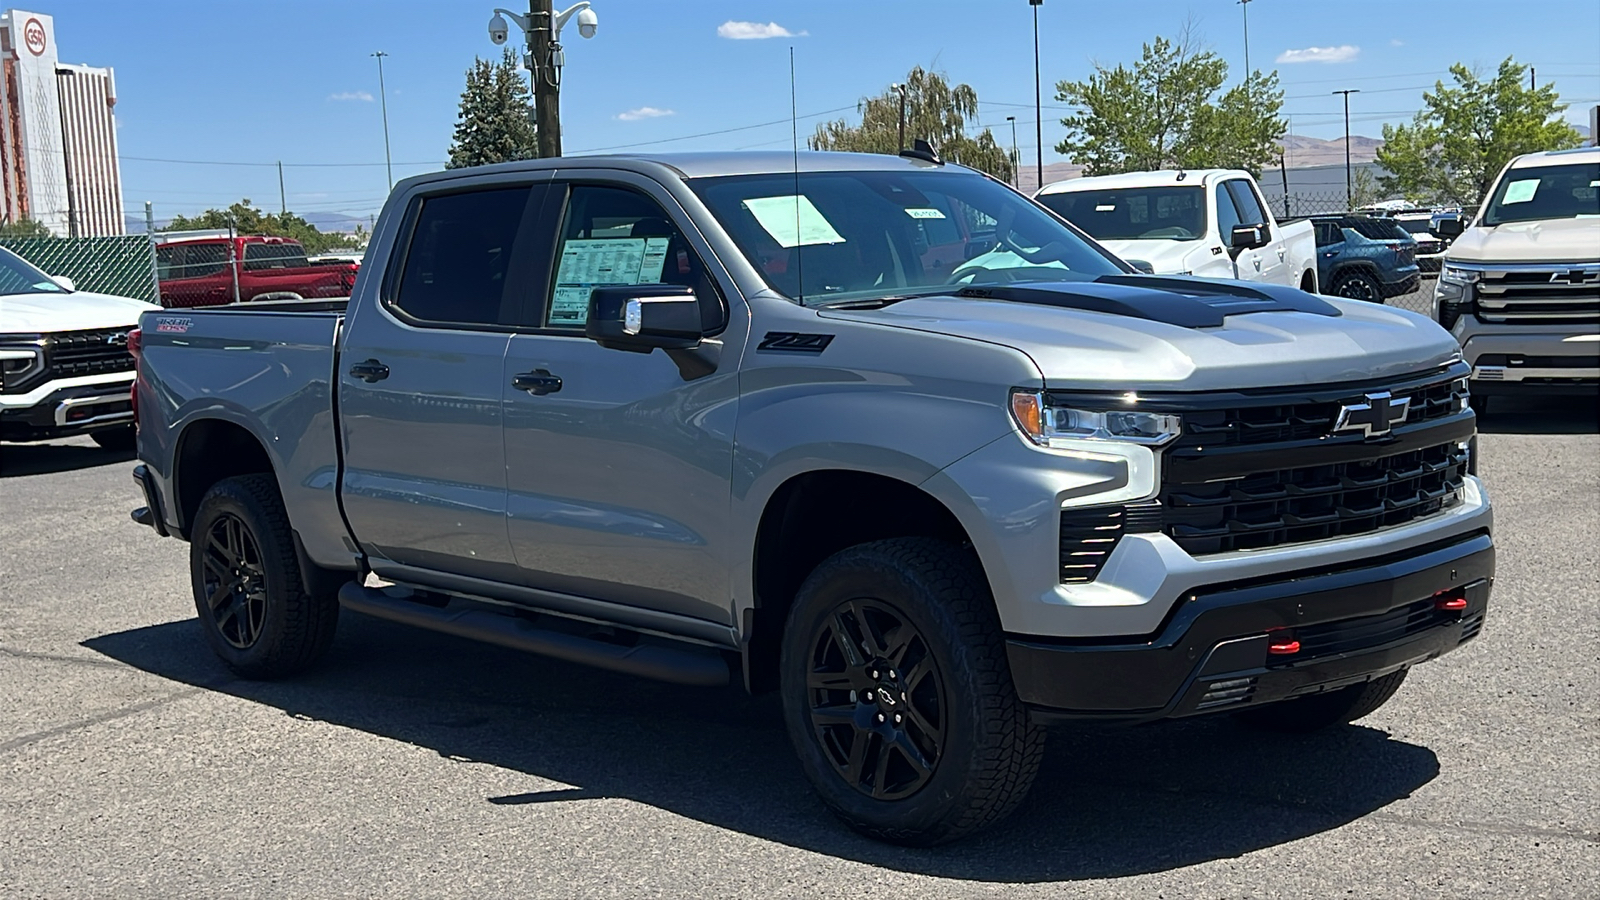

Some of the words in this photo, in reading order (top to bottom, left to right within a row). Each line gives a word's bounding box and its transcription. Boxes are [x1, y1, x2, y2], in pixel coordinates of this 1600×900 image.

[27, 29, 44, 47] GSR
[156, 317, 194, 327] TRAIL
[156, 324, 188, 333] BOSS
